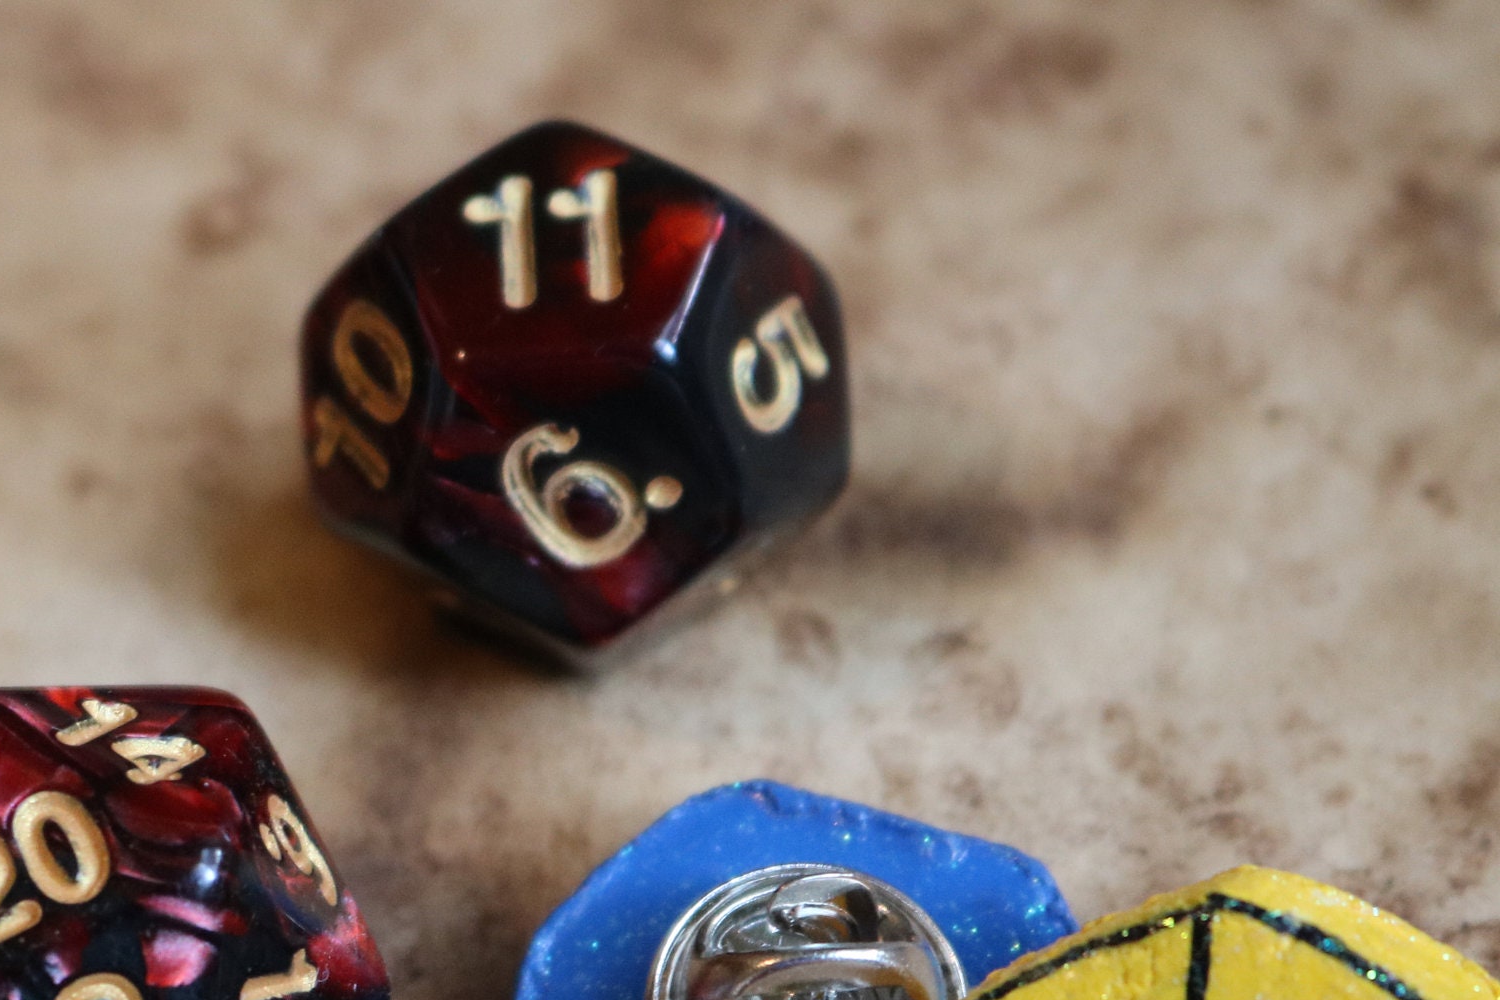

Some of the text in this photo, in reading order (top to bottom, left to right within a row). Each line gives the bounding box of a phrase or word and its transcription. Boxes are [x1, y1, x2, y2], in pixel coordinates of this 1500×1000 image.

[461, 167, 623, 309] 11
[311, 302, 413, 490] 10
[730, 295, 830, 433] 5
[55, 699, 206, 785] 14
